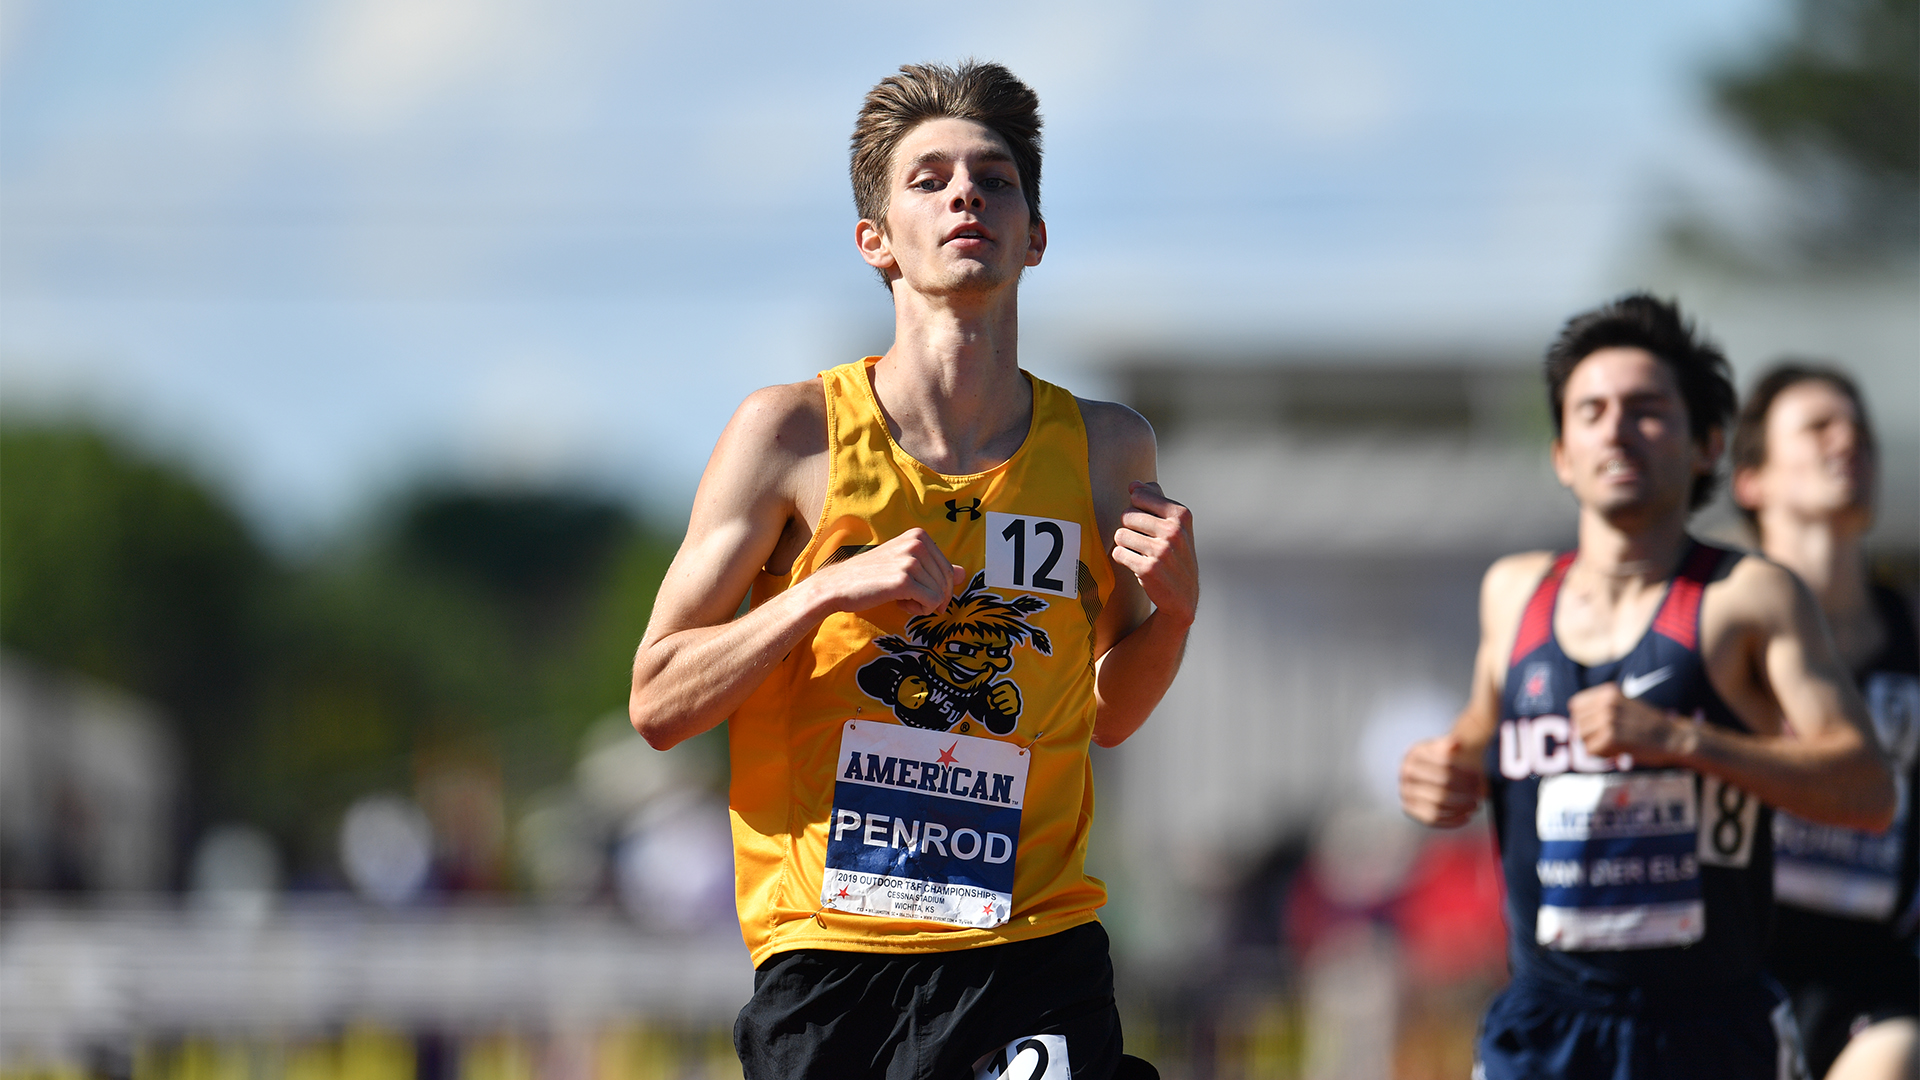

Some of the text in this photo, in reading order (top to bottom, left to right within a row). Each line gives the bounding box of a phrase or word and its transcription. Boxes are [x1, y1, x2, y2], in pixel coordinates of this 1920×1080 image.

[1001, 518, 1064, 592] 12
[929, 688, 960, 723] WSU
[844, 751, 1014, 804] AMERICAN
[834, 808, 1013, 864] PENROD
[838, 872, 997, 901] 2019 OUTDOOR T&F CHAMPIONSHIPS
[887, 890, 945, 904] CESSNA STADIUM
[895, 902, 923, 913] WICHITA,
[925, 905, 935, 914] KS
